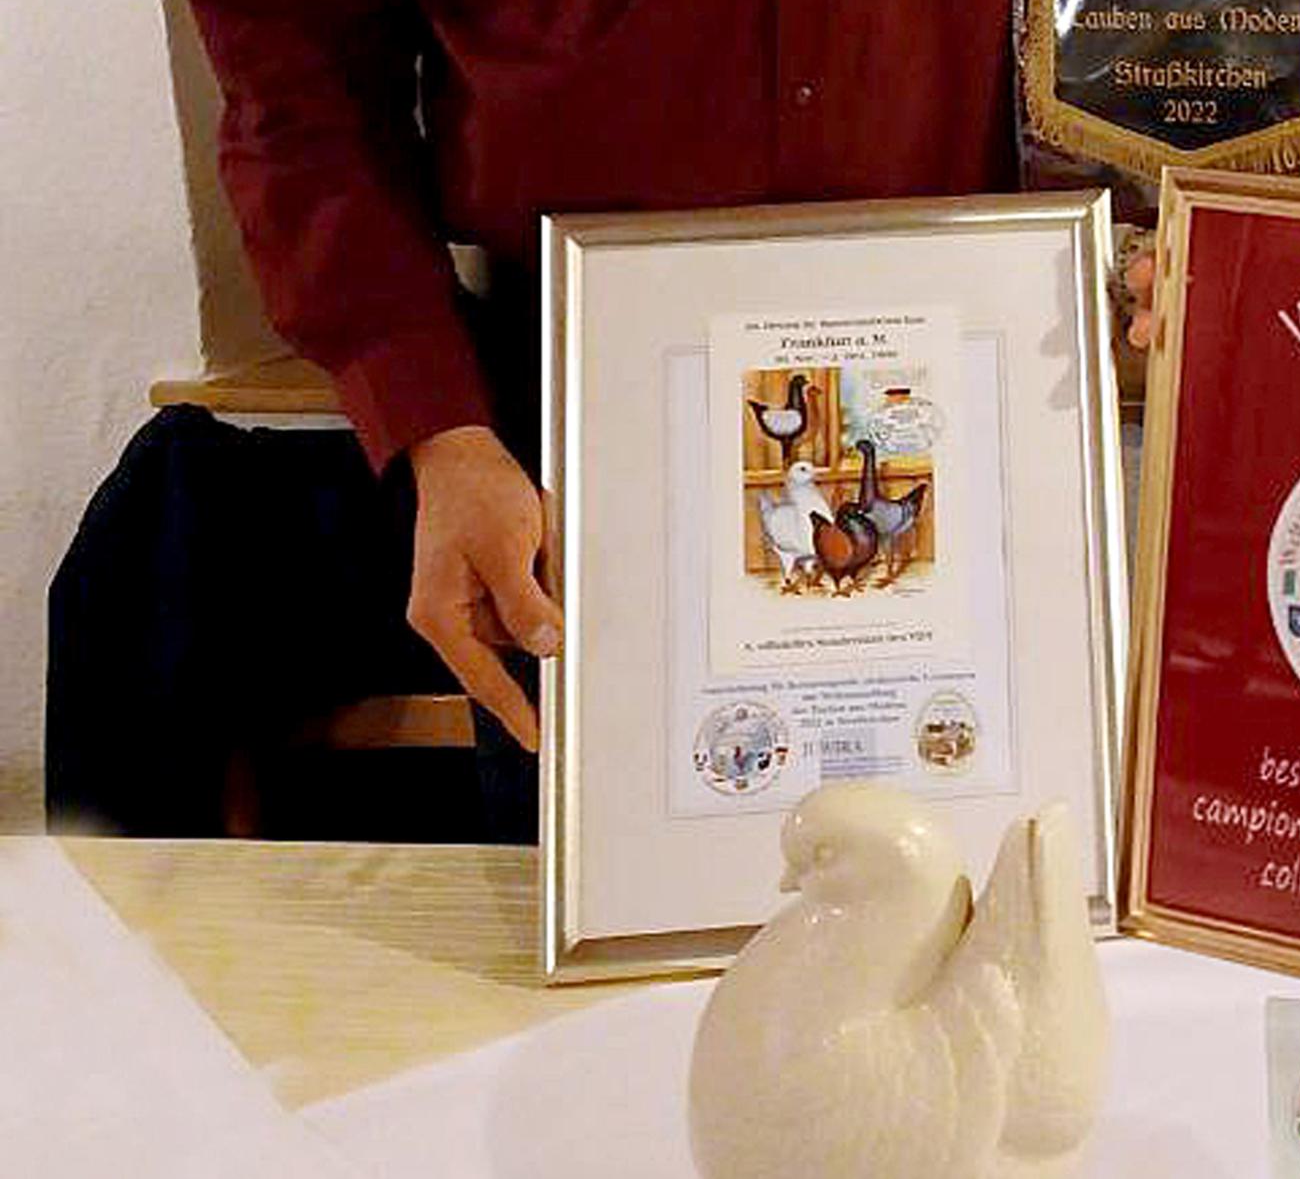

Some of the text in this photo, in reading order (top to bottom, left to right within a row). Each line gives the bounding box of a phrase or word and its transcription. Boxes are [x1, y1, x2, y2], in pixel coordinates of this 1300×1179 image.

[1165, 10, 1207, 31] aus
[1115, 60, 1268, 91] Straßkirchen
[1163, 99, 1219, 124] 2022
